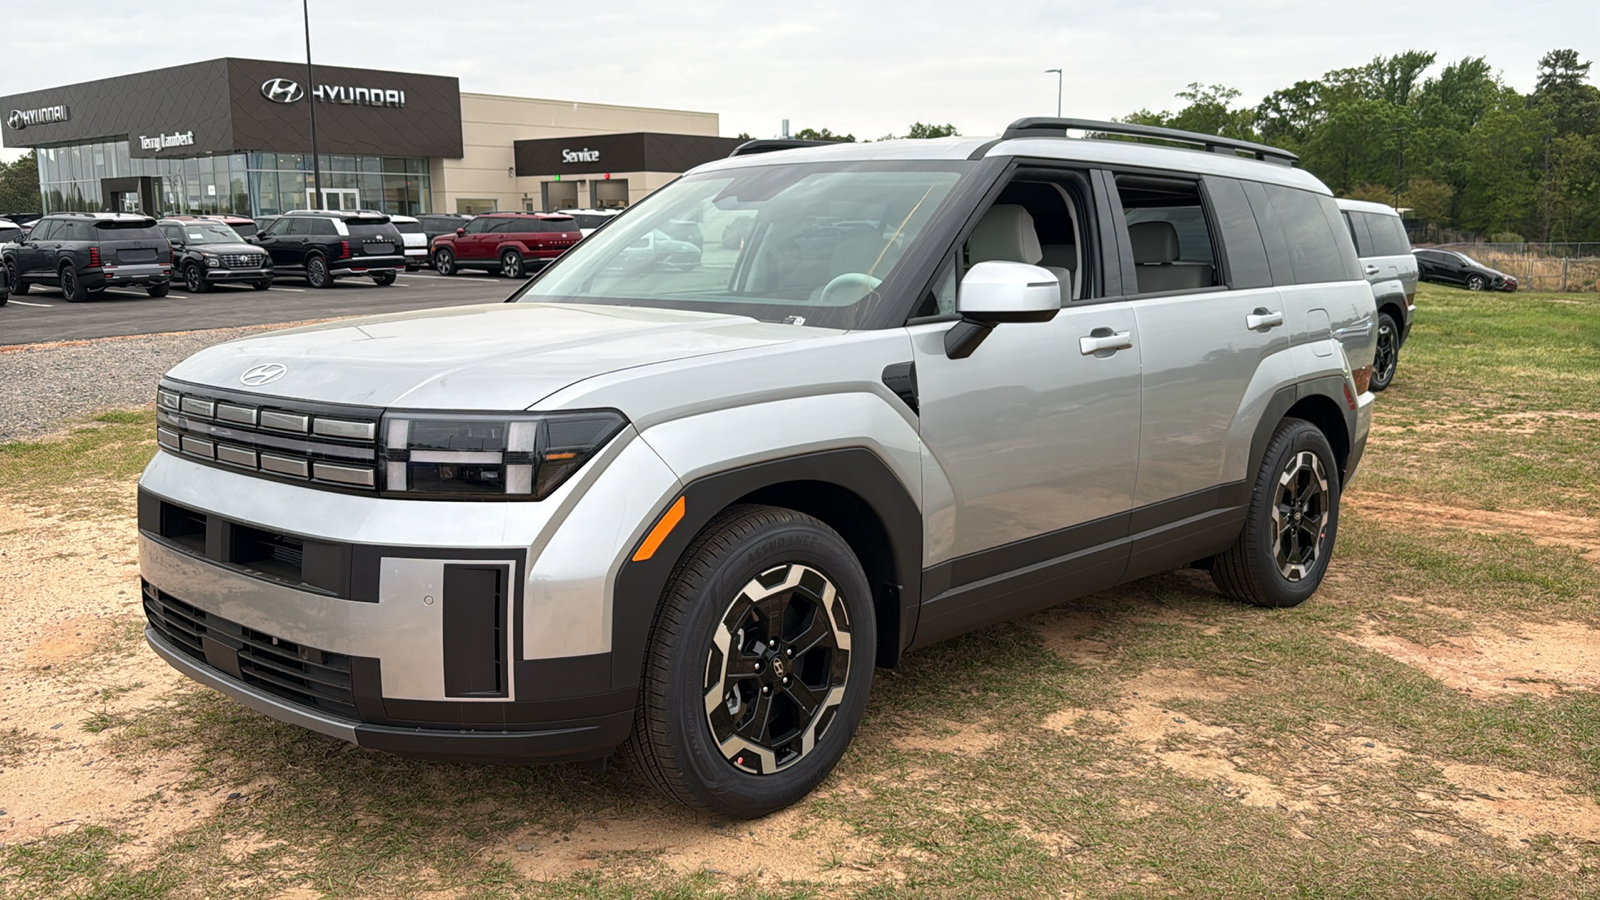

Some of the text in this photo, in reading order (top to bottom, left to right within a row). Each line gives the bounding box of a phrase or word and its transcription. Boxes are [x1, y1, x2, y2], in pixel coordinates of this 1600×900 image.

[312, 85, 405, 106] HYUNDAI
[23, 105, 67, 125] HYUNDAI
[139, 131, 194, 152] Terry Lambert
[562, 148, 600, 163] Service
[747, 534, 818, 565] ASSURANCE
